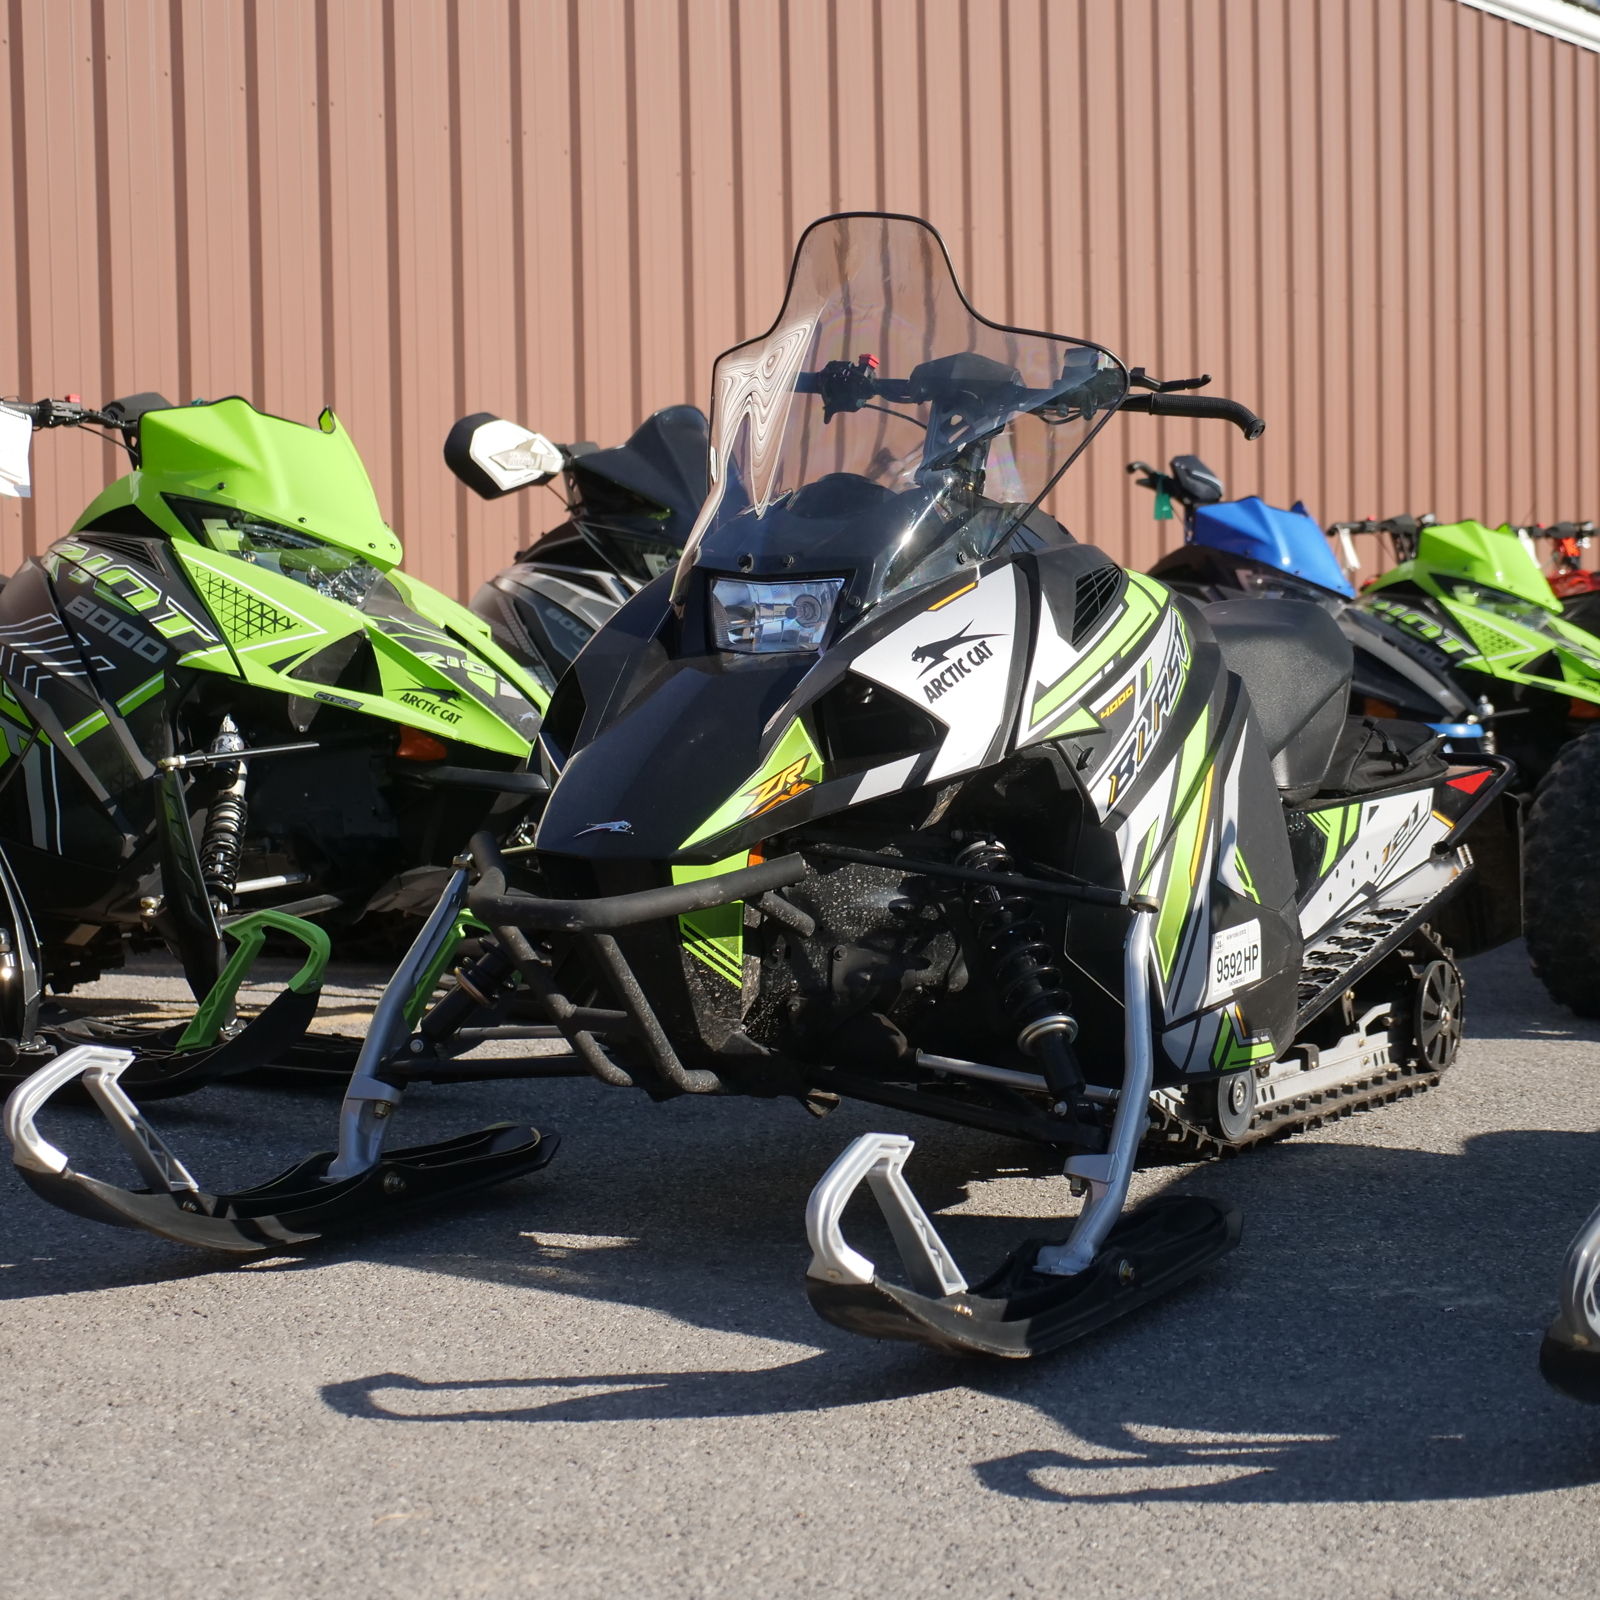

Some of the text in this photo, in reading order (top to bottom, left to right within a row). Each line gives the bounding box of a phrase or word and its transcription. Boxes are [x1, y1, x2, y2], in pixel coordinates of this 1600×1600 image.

[64, 595, 168, 664] 8000
[413, 651, 510, 688] RIO
[922, 639, 994, 704] ARCTIC CAT
[399, 692, 463, 725] ARCTIC CAT
[1100, 684, 1135, 720] 4000
[741, 754, 810, 813] ZR
[1382, 800, 1420, 867] 121
